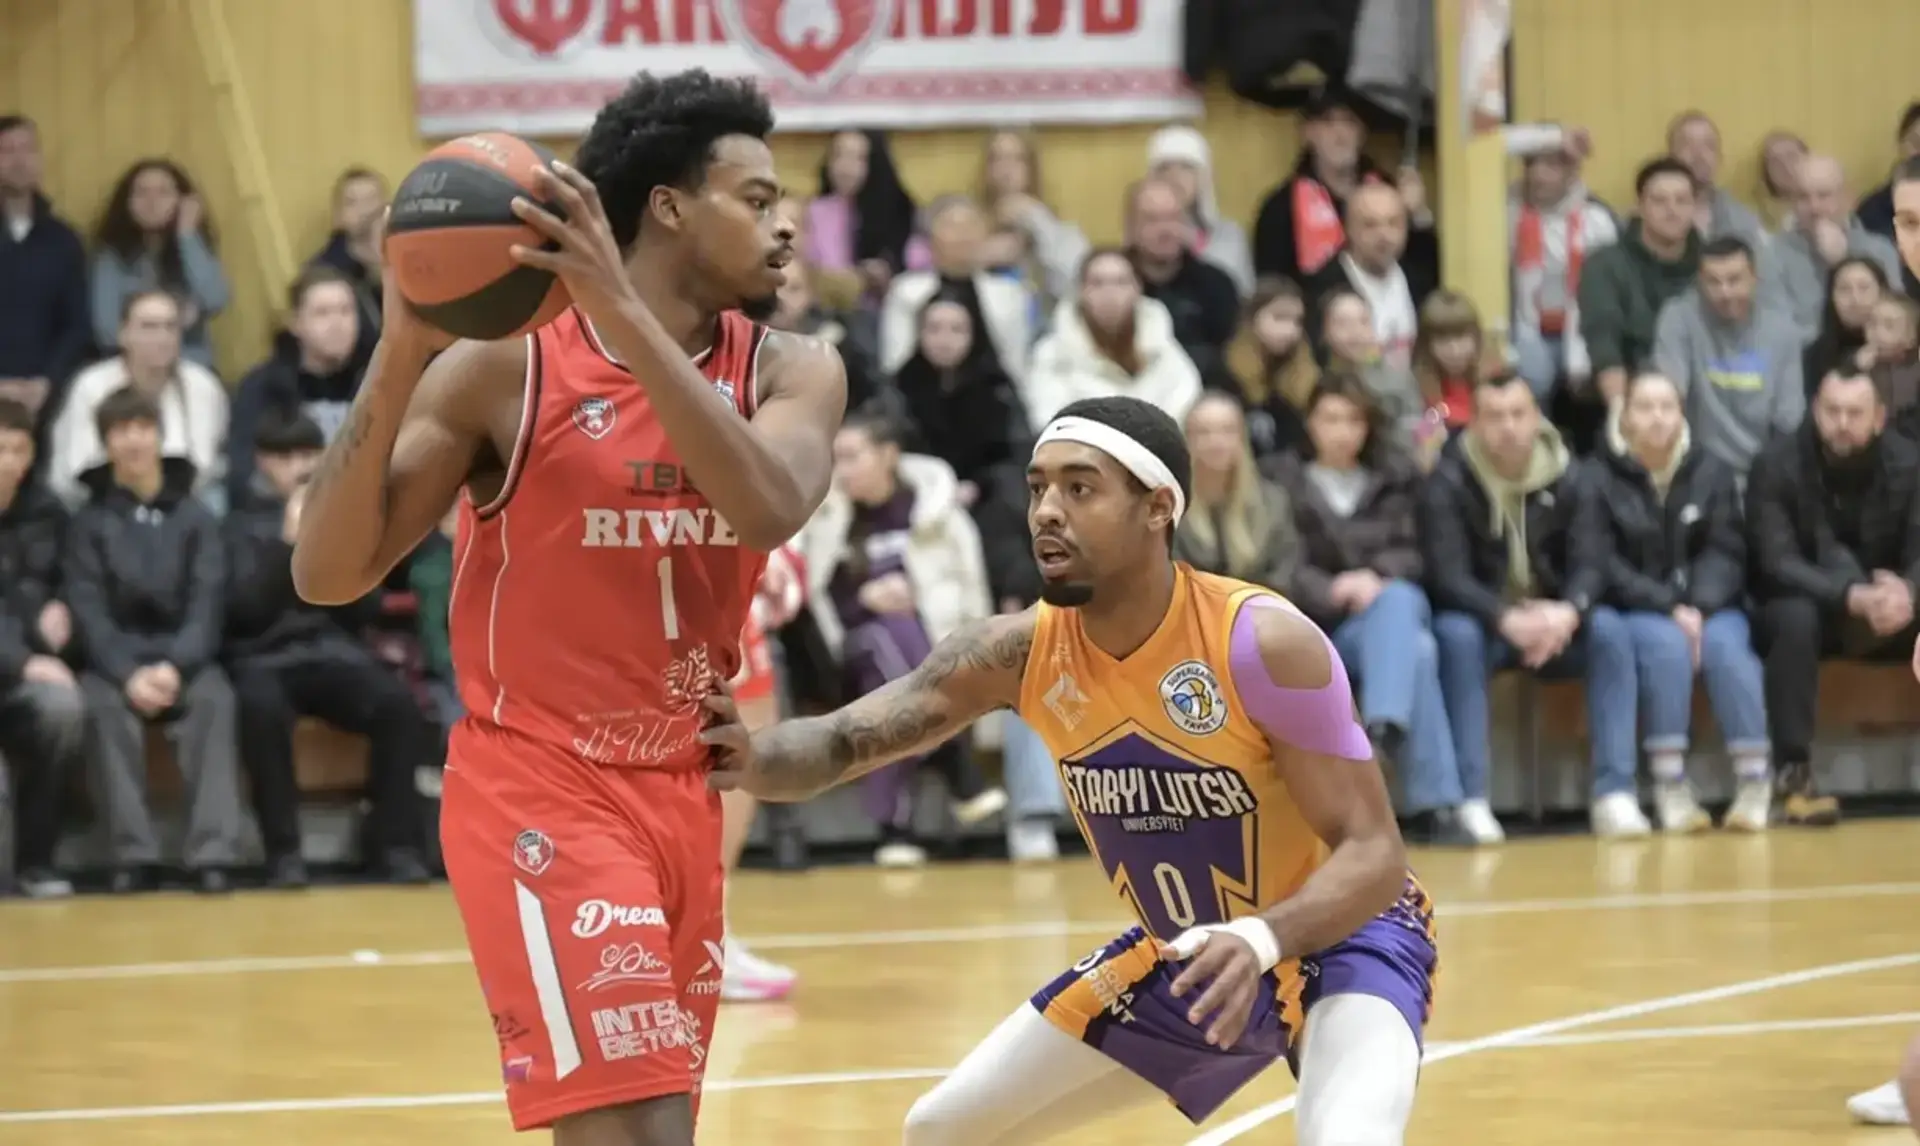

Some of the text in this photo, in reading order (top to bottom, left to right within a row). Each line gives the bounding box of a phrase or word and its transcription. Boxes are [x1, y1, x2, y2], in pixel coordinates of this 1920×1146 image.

[657, 556, 680, 640] 1
[1062, 764, 1256, 819] STARYI LUTSK
[1121, 816, 1185, 832] UNIVERSYTET
[1153, 862, 1196, 929] 0
